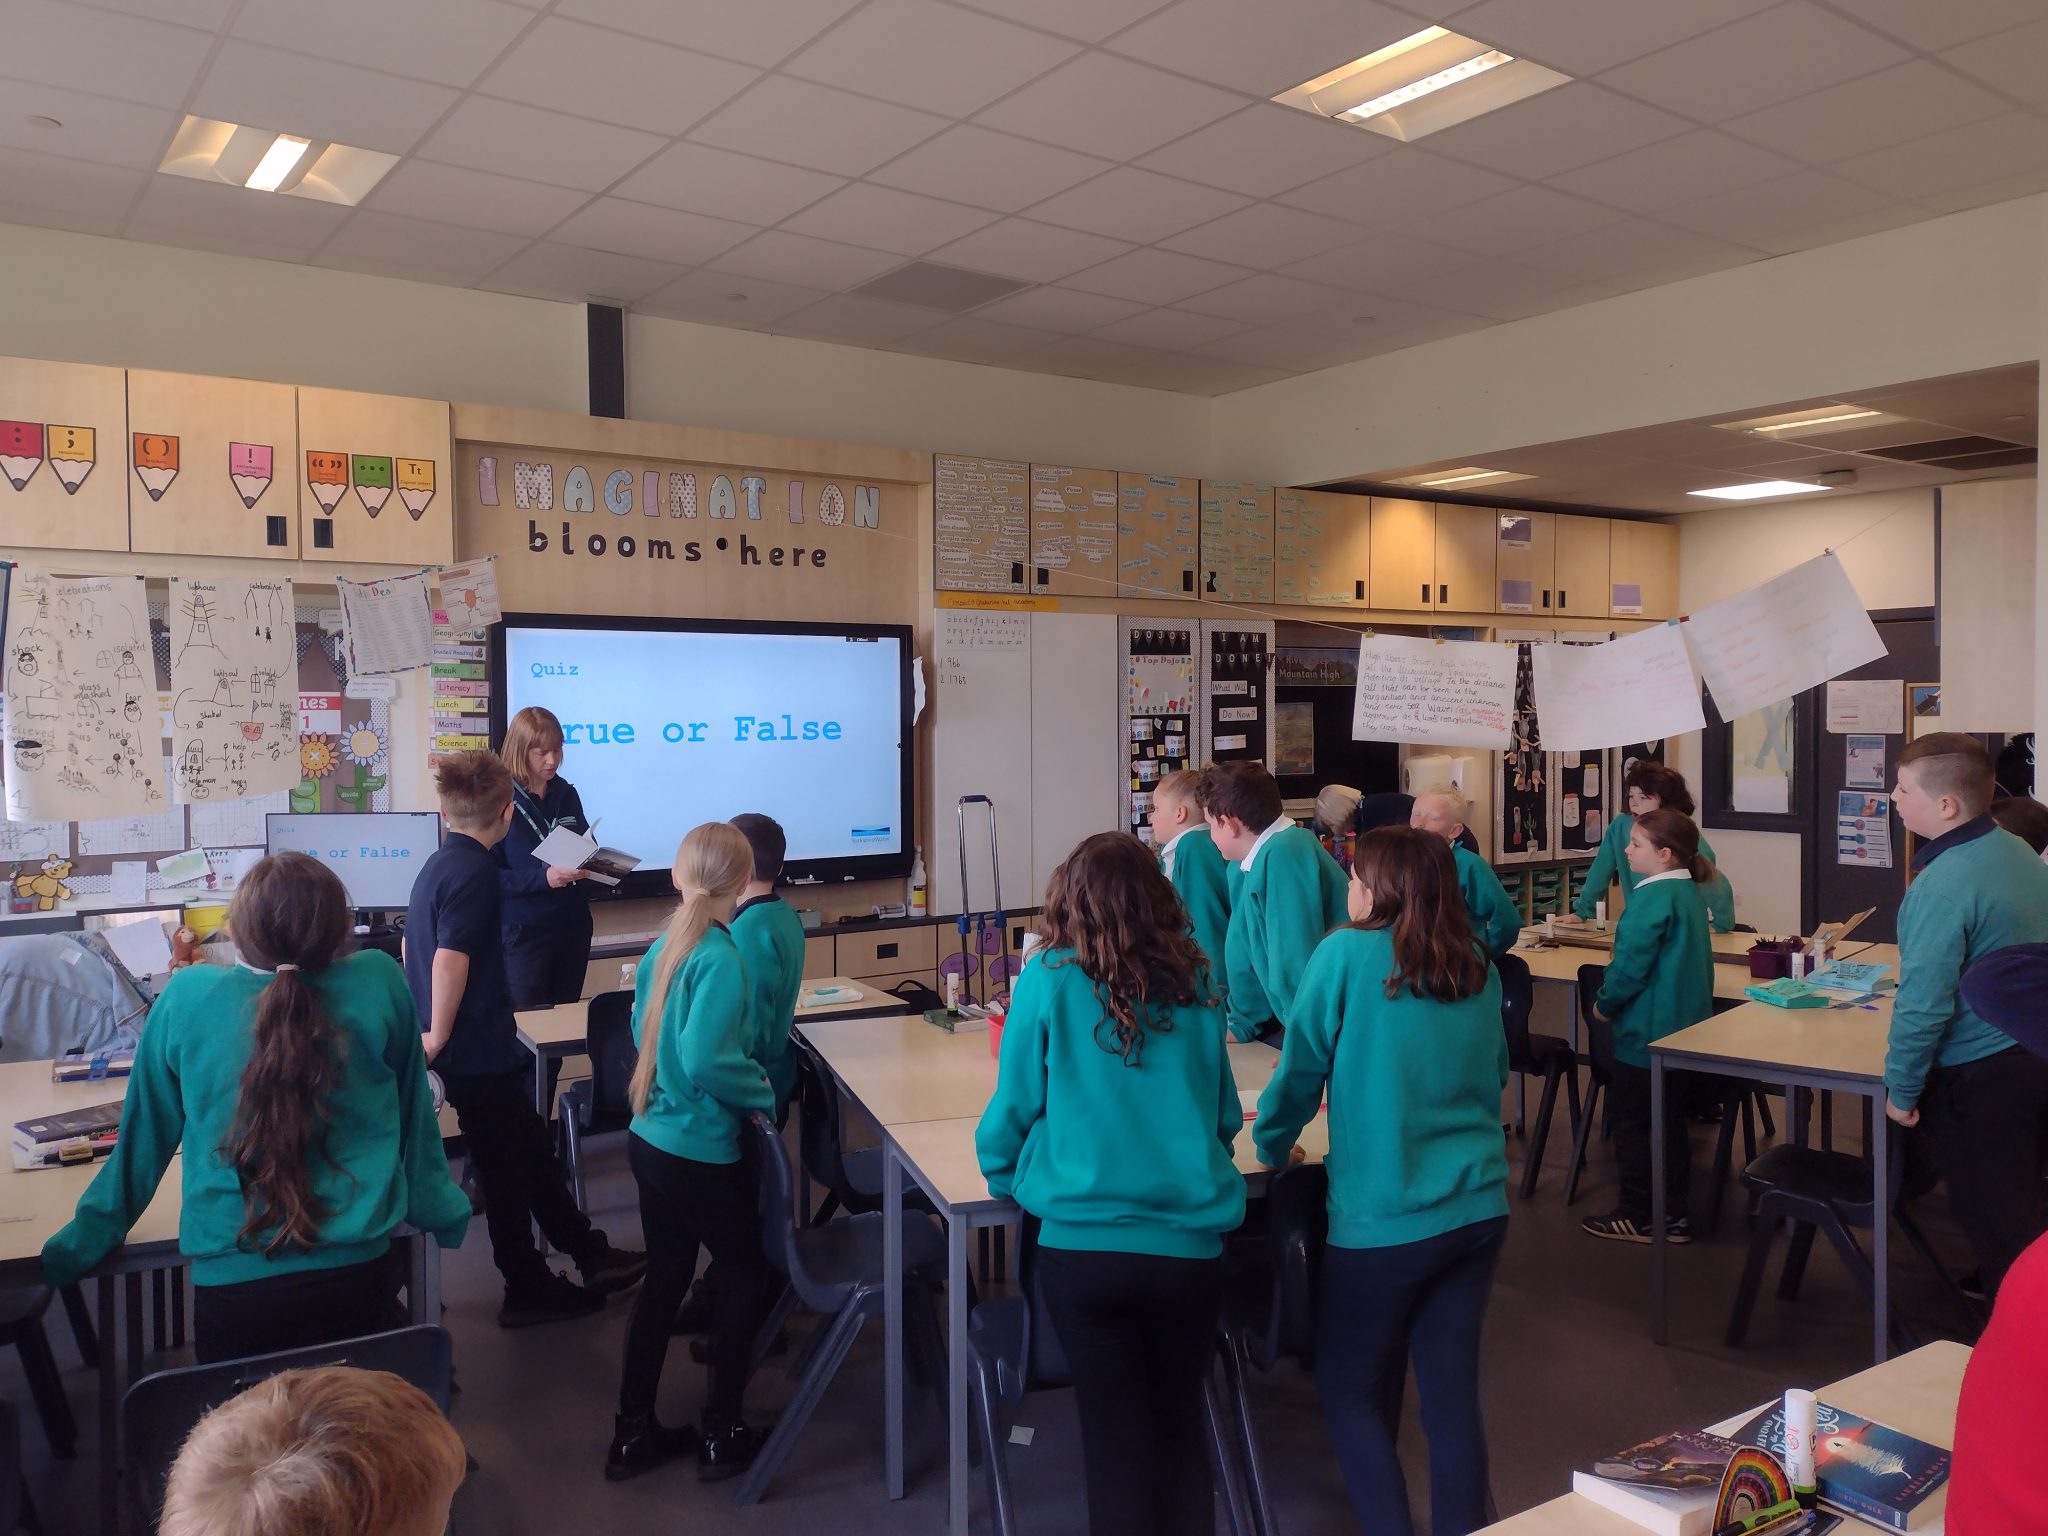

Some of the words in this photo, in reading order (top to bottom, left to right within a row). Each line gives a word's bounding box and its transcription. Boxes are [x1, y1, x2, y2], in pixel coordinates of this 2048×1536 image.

[479, 456, 880, 529] IMAGINATION
[529, 520, 702, 562] blooms
[740, 534, 827, 568] here
[1134, 630, 1187, 640] DOJOS
[1222, 633, 1227, 642] I
[1240, 634, 1259, 643] AM
[12, 644, 44, 656] shock
[1142, 656, 1159, 666] Top
[434, 666, 457, 674] Break
[530, 662, 579, 679] Quiz
[1280, 668, 1318, 678] Mountain
[1320, 669, 1340, 682] High
[440, 684, 471, 693] Literacy
[1364, 682, 1377, 692] all
[1464, 688, 1478, 696] the
[1222, 710, 1232, 719] Do
[1236, 710, 1256, 718] Now?
[438, 721, 462, 729] Maths
[562, 722, 635, 745] rue
[662, 722, 709, 743] or
[734, 714, 842, 743] False
[329, 849, 348, 858] or
[360, 846, 410, 858] False
